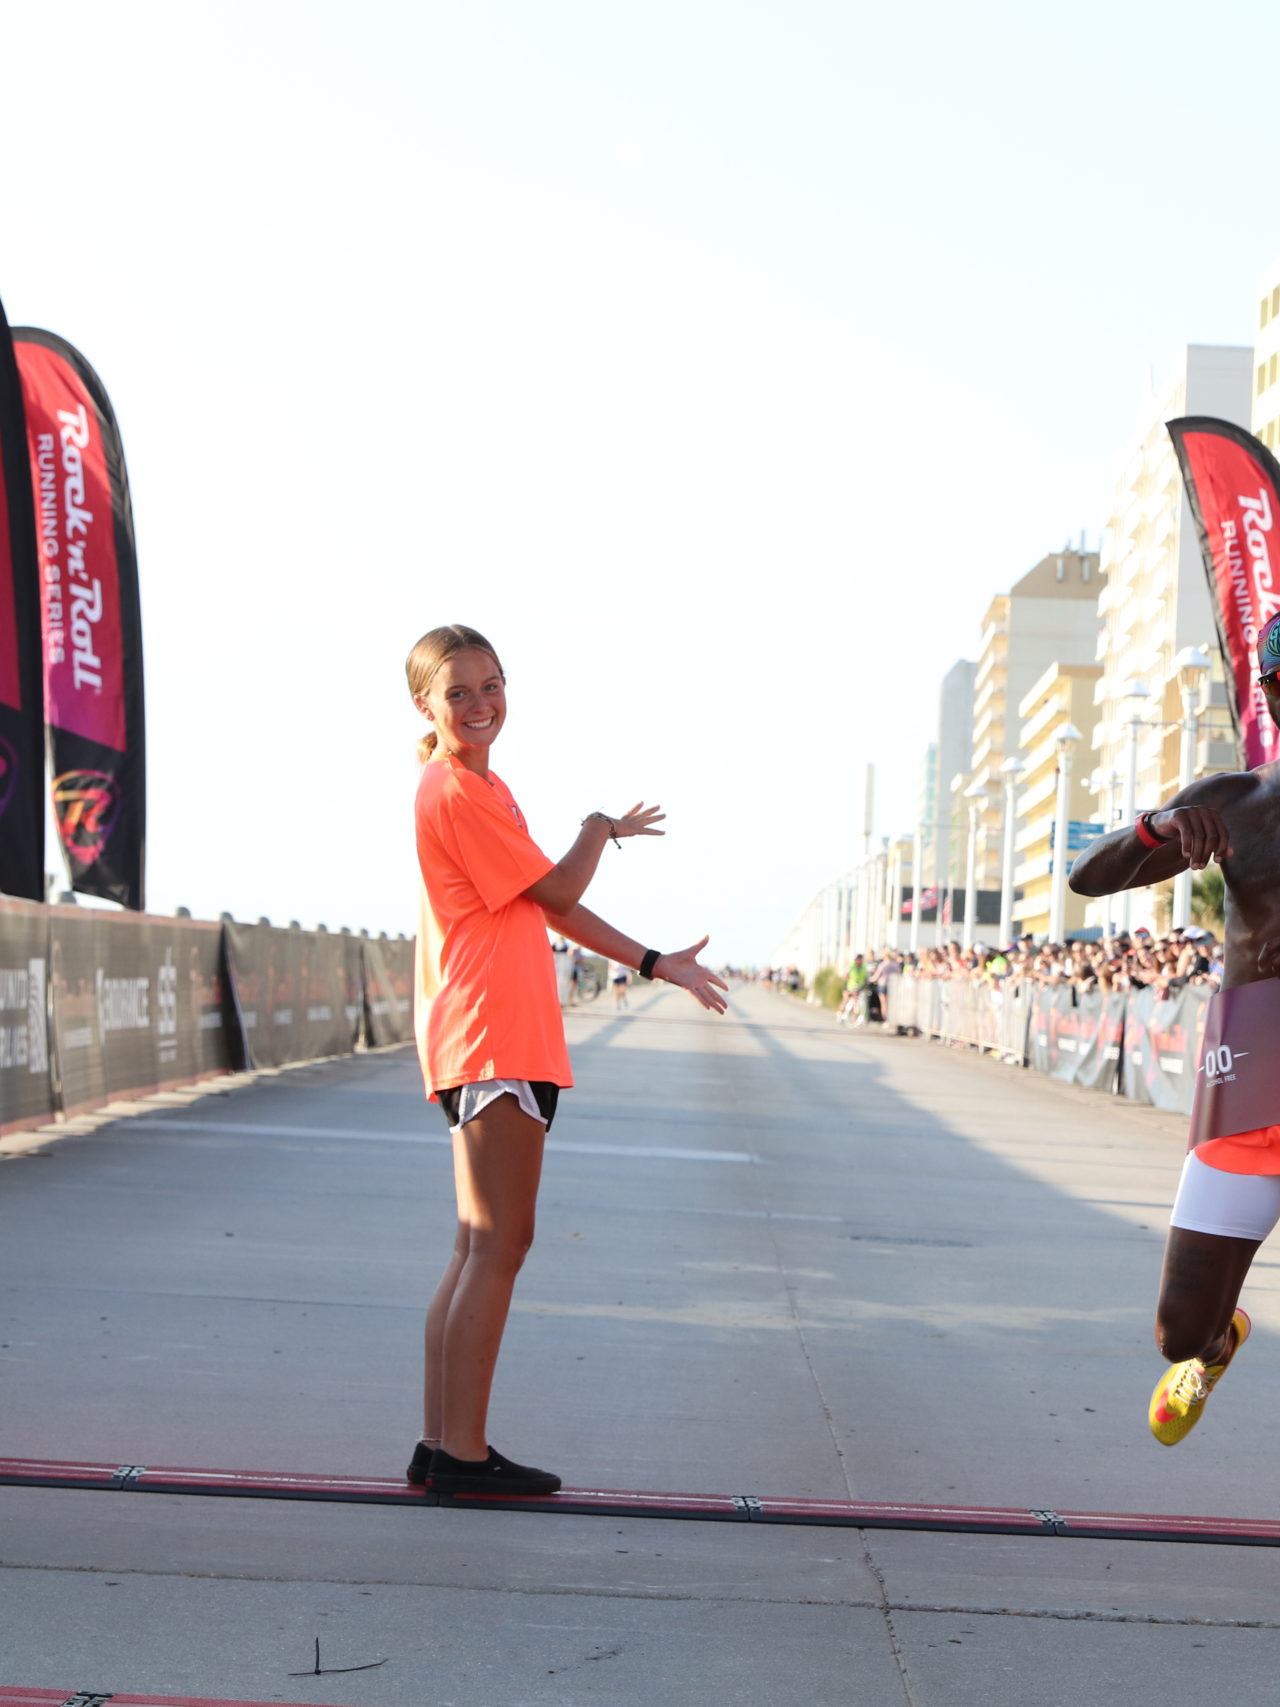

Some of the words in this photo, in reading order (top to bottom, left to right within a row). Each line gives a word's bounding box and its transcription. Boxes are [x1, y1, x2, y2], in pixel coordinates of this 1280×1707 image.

[37, 433, 60, 558] RUNNING
[45, 564, 65, 664] SERIES
[1221, 520, 1259, 644] RUNNING
